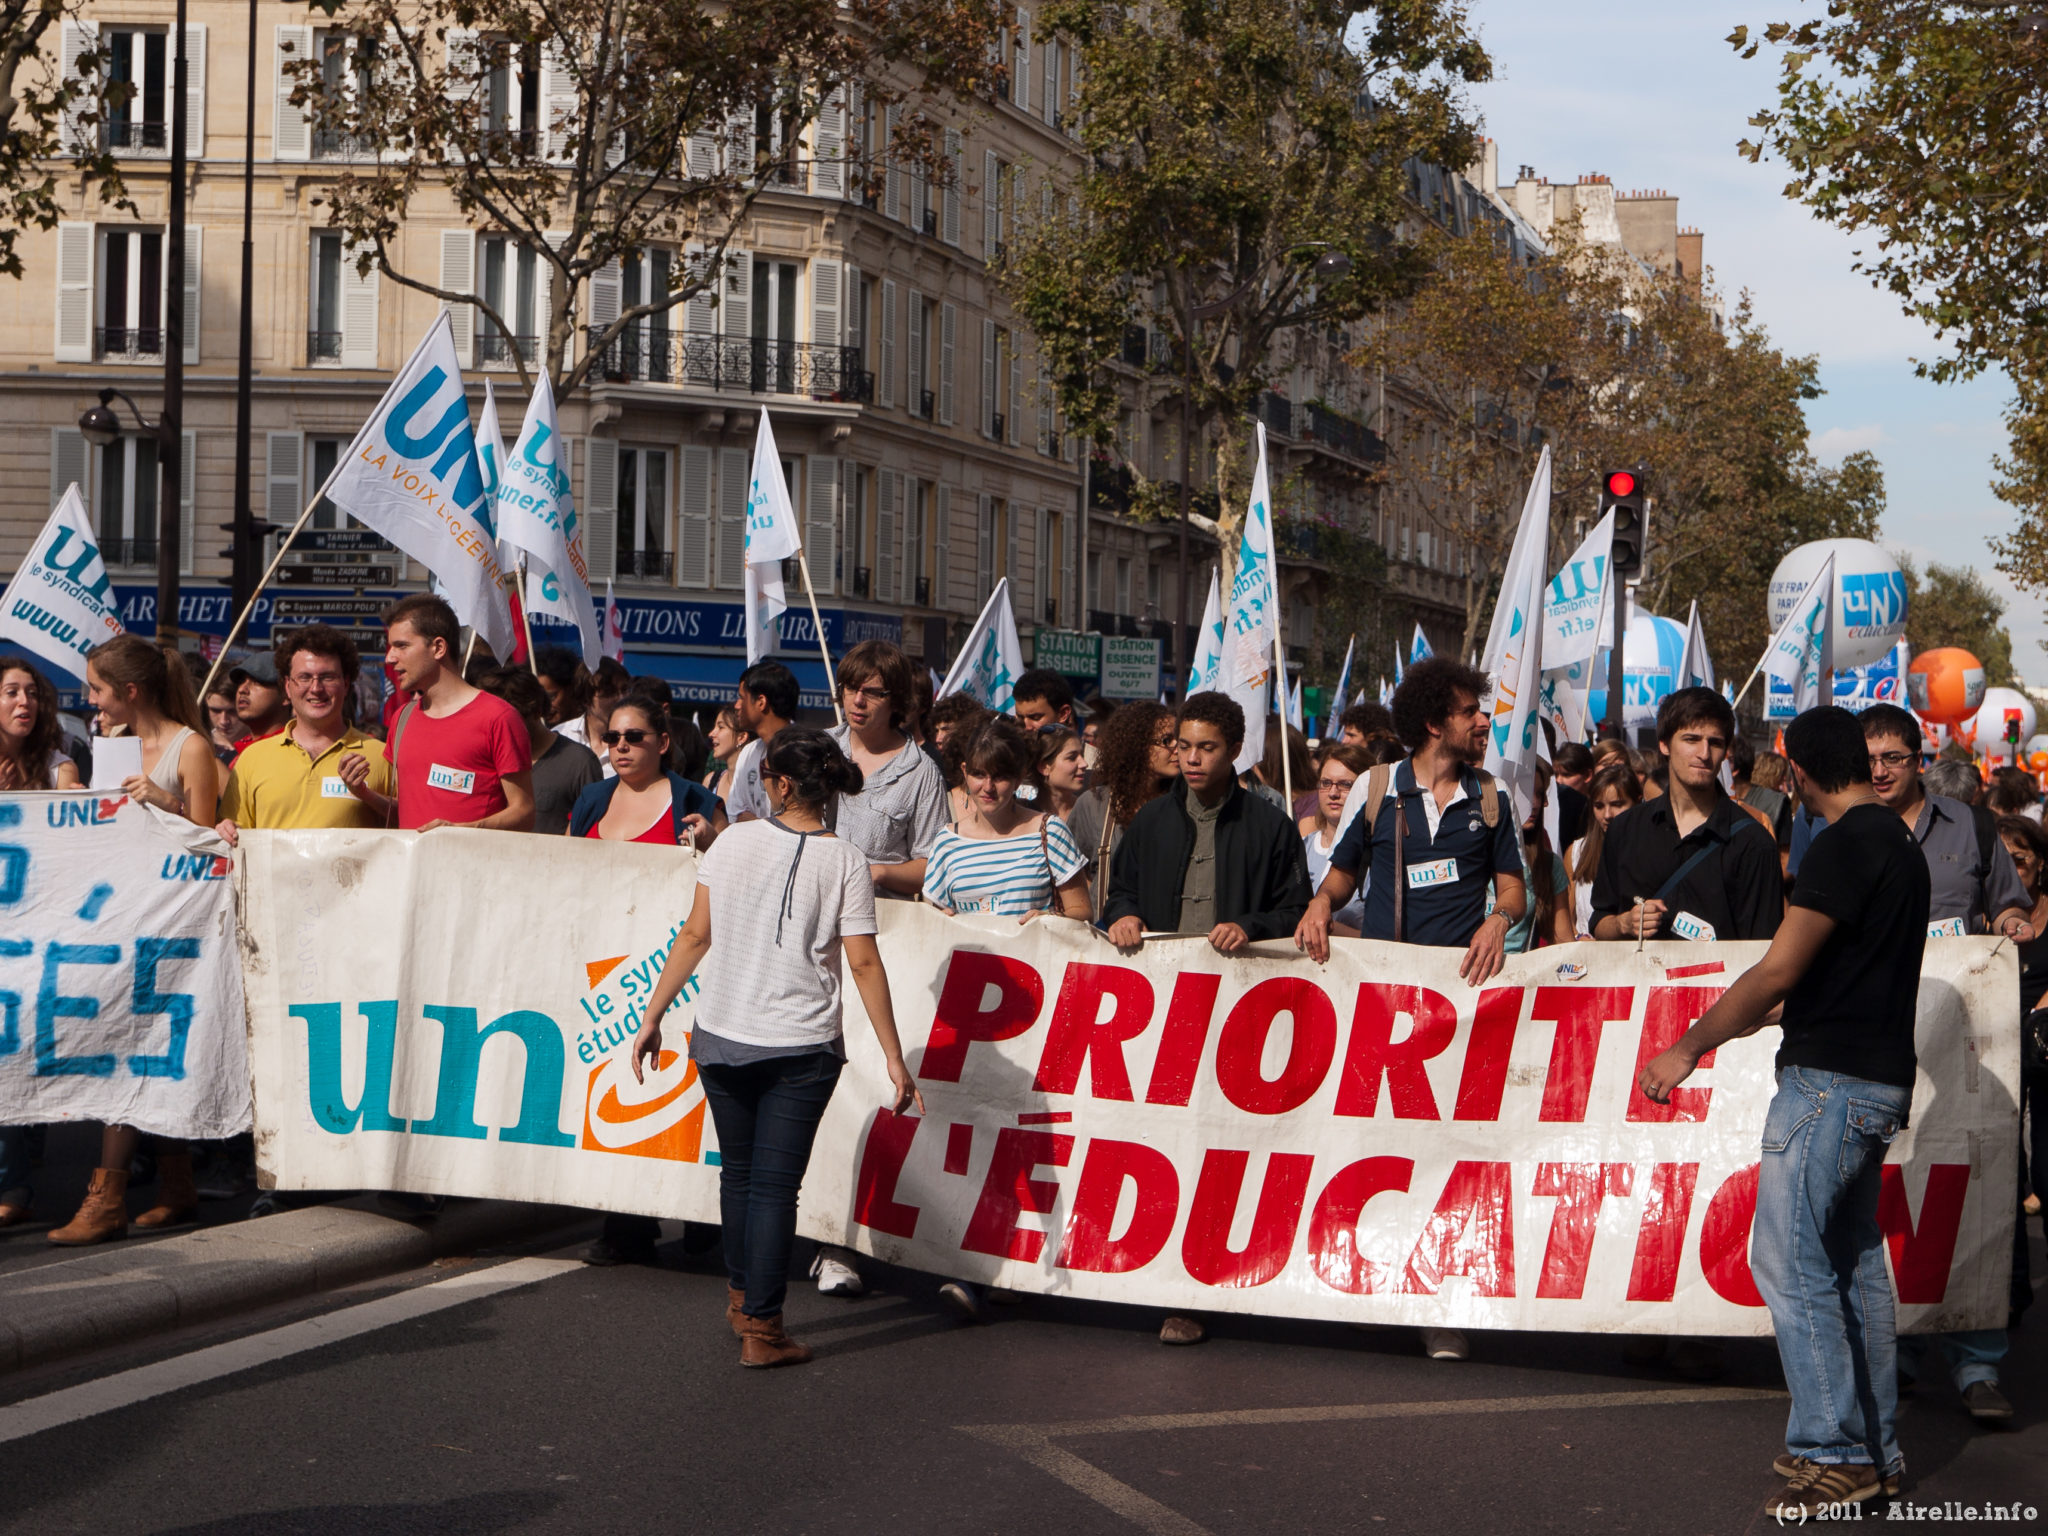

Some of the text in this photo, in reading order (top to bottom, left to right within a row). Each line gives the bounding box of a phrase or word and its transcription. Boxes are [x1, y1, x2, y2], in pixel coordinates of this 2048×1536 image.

[360, 445, 388, 471] LA
[392, 465, 439, 506] VOIX
[436, 503, 507, 591] LYCÉENNE
[42, 568, 107, 619] syndicat
[322, 603, 353, 611] MARCO
[354, 603, 376, 611] POLO
[1039, 634, 1096, 654] STATION
[1109, 639, 1154, 651] STATION
[1036, 652, 1097, 674] ESSENCE
[1105, 653, 1157, 665] ESSENCE
[1108, 670, 1153, 679] OUVERT
[430, 770, 474, 789] unef
[1410, 860, 1455, 883] unef
[958, 896, 998, 913] unef
[579, 993, 615, 1023] le
[919, 949, 1728, 1123] PRIORITÉ
